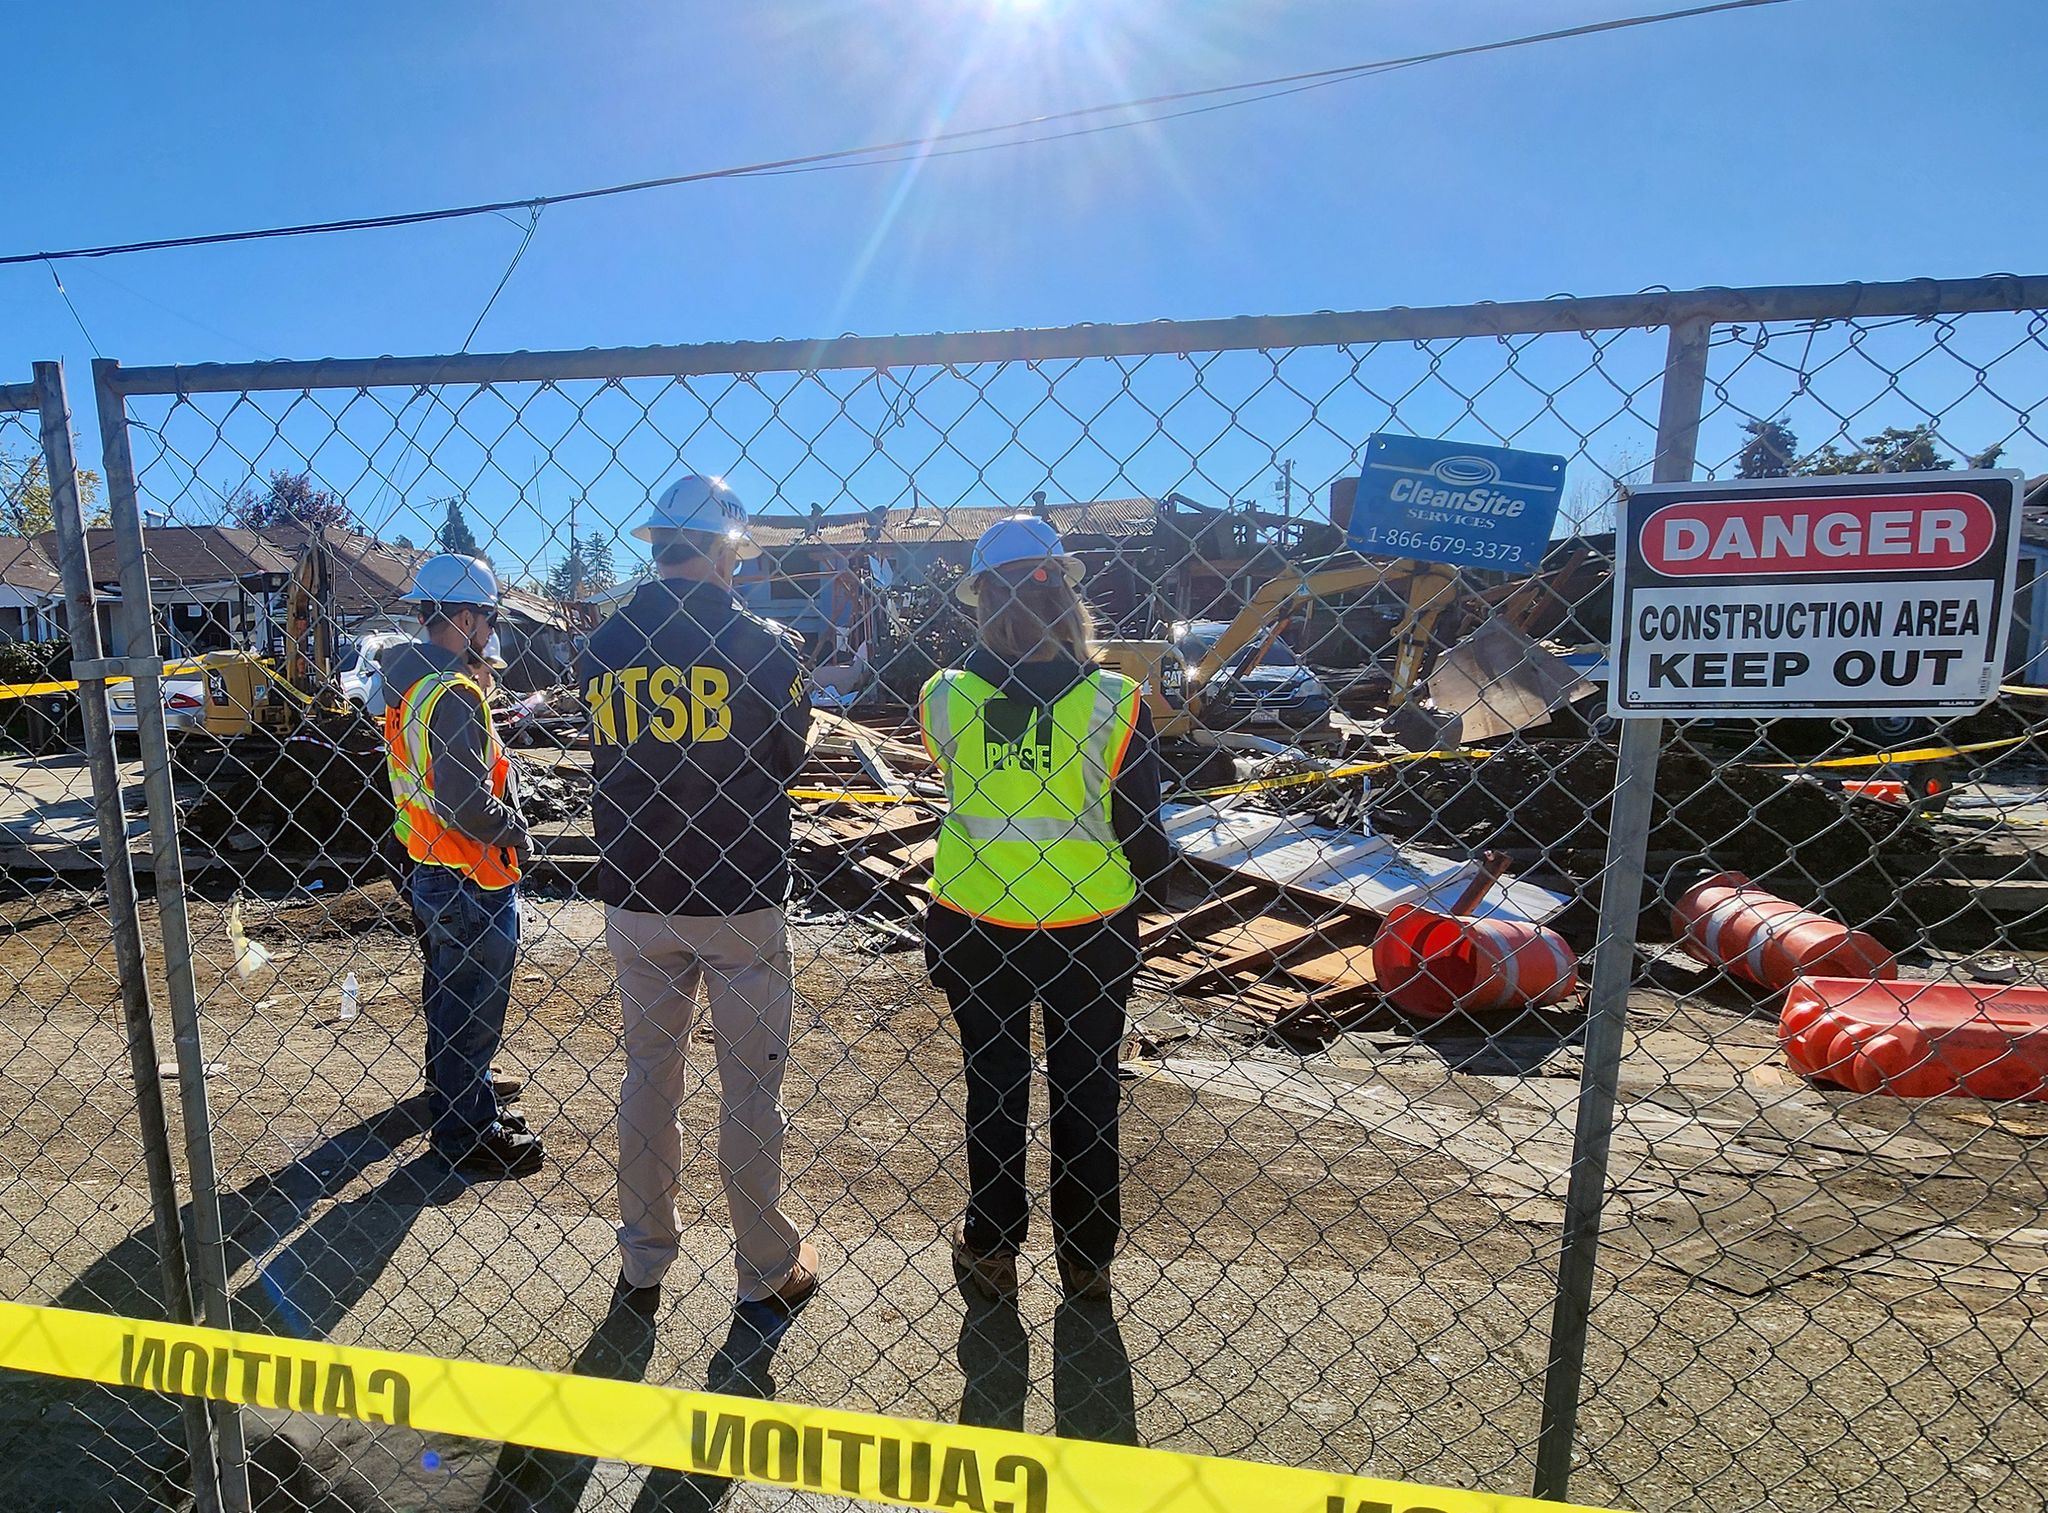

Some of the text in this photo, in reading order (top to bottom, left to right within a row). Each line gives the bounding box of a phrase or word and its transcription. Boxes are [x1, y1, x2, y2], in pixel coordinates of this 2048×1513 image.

[1390, 478, 1526, 518] CleanSite
[1407, 508, 1496, 529] SERVICES
[1663, 509, 1968, 561] DANGER
[1368, 526, 1522, 562] 1-866-679-3373
[1639, 599, 1980, 642] CONSTRUCTION AREA
[1648, 649, 1962, 689] KEEP OUT
[585, 665, 732, 746] NTSB
